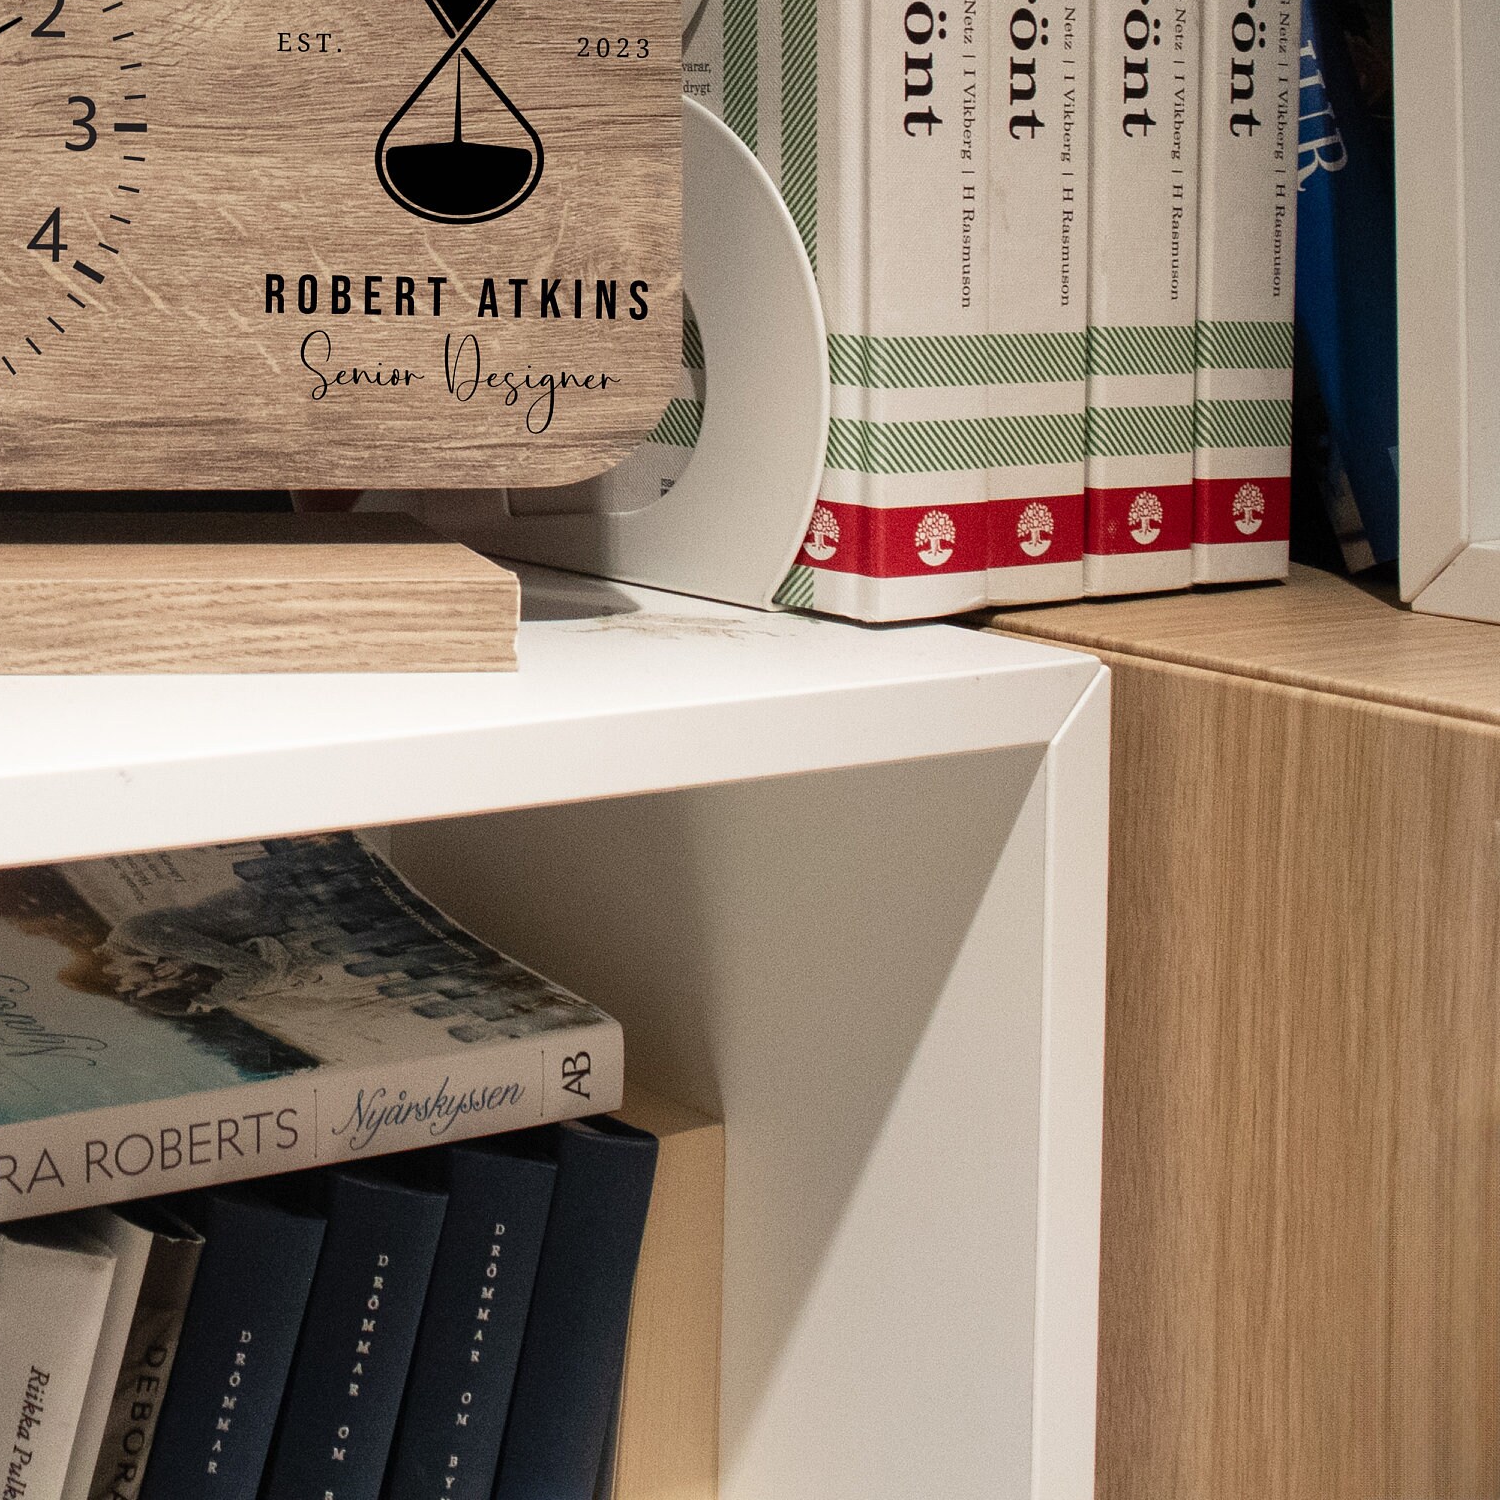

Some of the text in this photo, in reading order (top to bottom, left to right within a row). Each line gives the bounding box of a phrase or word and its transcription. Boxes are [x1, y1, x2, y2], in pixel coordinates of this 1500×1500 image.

[276, 32, 343, 53] EST.
[576, 37, 651, 59] 2023
[963, 0, 977, 45] Netz
[1063, 5, 1076, 50] Netz
[1174, 8, 1187, 51] Netz
[1278, 12, 1291, 54] Netz
[683, 79, 712, 96] drygt
[963, 68, 976, 78] I
[1063, 74, 1076, 82] I
[65, 96, 98, 152] 3
[960, 83, 976, 161] Vikberg
[1060, 87, 1076, 163] Vikberg
[1170, 86, 1185, 160] Vikberg
[1274, 88, 1289, 161] Vikberg
[962, 185, 975, 201] H
[1062, 187, 1074, 202] H
[1172, 184, 1184, 199] H
[1275, 184, 1286, 198] H
[26, 207, 68, 262] 4
[961, 207, 975, 308] Rasmuson
[1061, 210, 1074, 307] Rasmuson
[1170, 206, 1183, 300] Rasmuson
[1273, 205, 1287, 298] Rasmuson
[265, 273, 650, 321] ROBERT ATKINS
[300, 330, 622, 435] Senior Designer
[561, 1050, 592, 1100] AB
[332, 1076, 526, 1151] Nyårskyssen
[84, 1108, 300, 1183] ROBERTS
[331, 1253, 389, 1461] DRÖMMAR OM
[440, 1222, 506, 1500] DRÖMMAR OM BY
[16, 1364, 51, 1442] Riikka
[207, 1329, 252, 1475] DRÖMMAR
